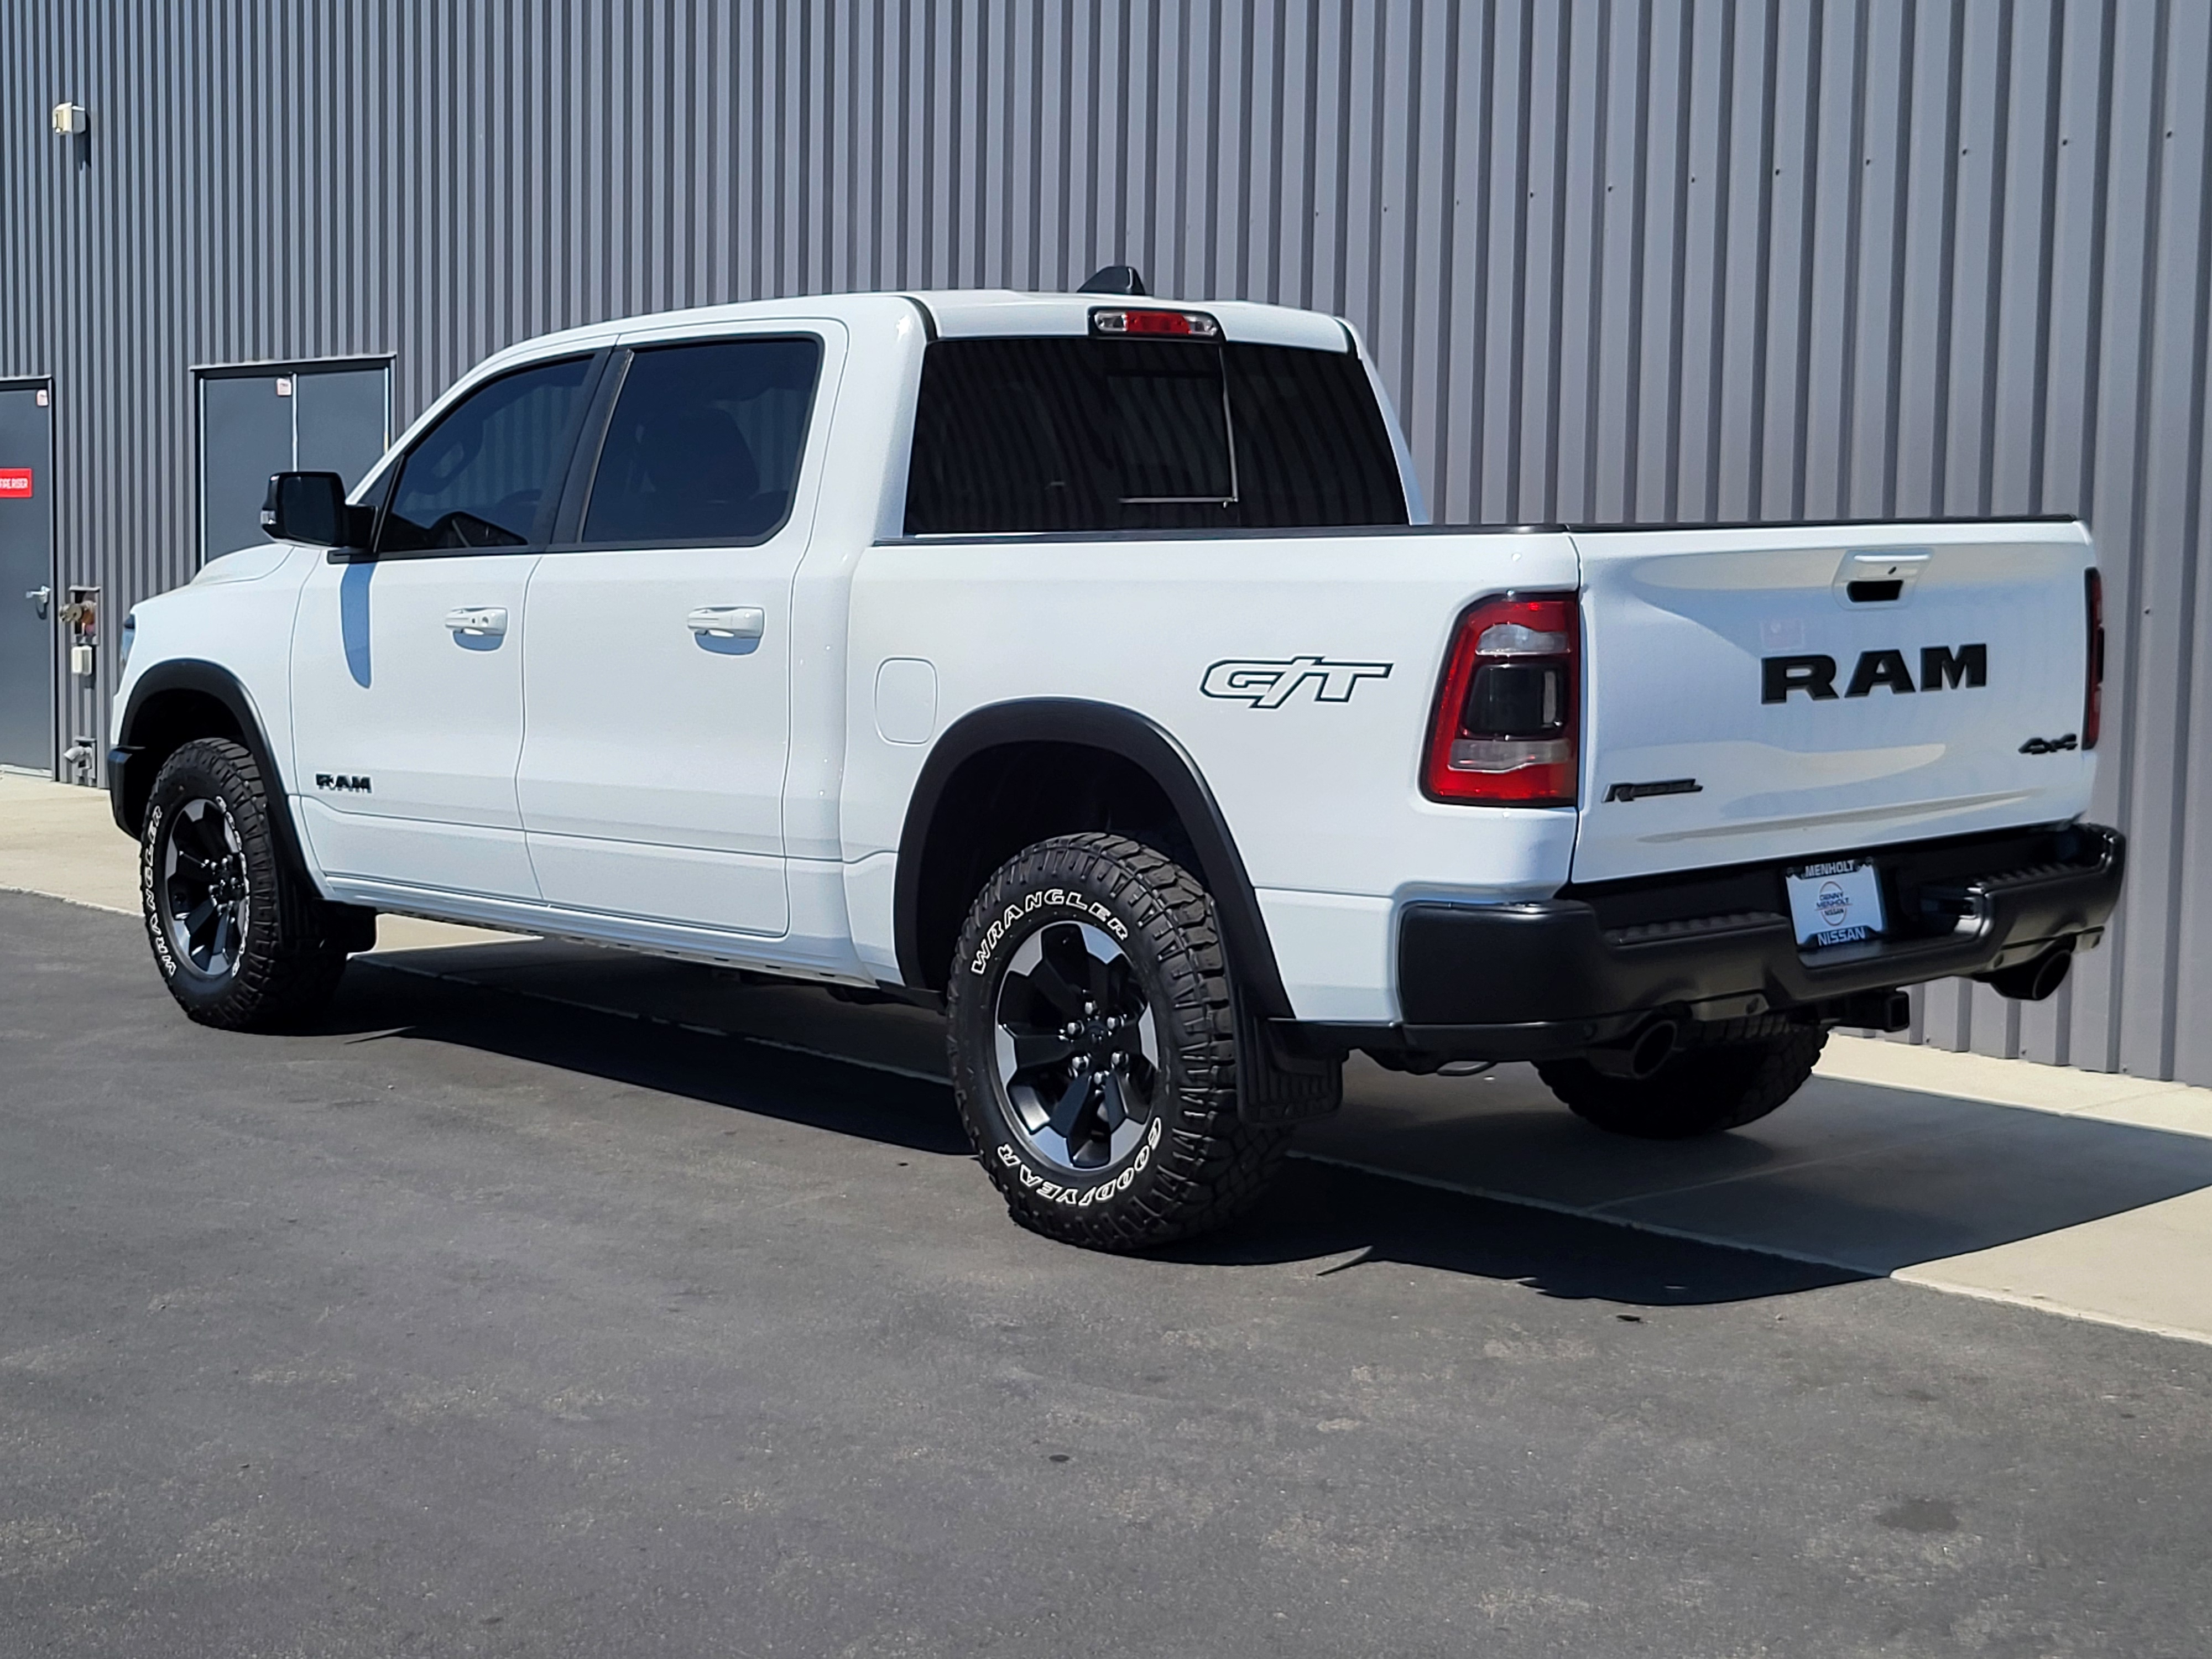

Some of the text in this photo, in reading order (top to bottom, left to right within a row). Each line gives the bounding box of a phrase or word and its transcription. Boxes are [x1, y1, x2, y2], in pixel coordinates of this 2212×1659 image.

[1761, 643, 1987, 705] RAM
[316, 773, 371, 792] RAM
[1805, 860, 1854, 877] MENHOLT
[971, 889, 1129, 975] WRANGLER
[1817, 927, 1866, 946] NISSAN
[997, 1117, 1161, 1206] GOODYEAR
